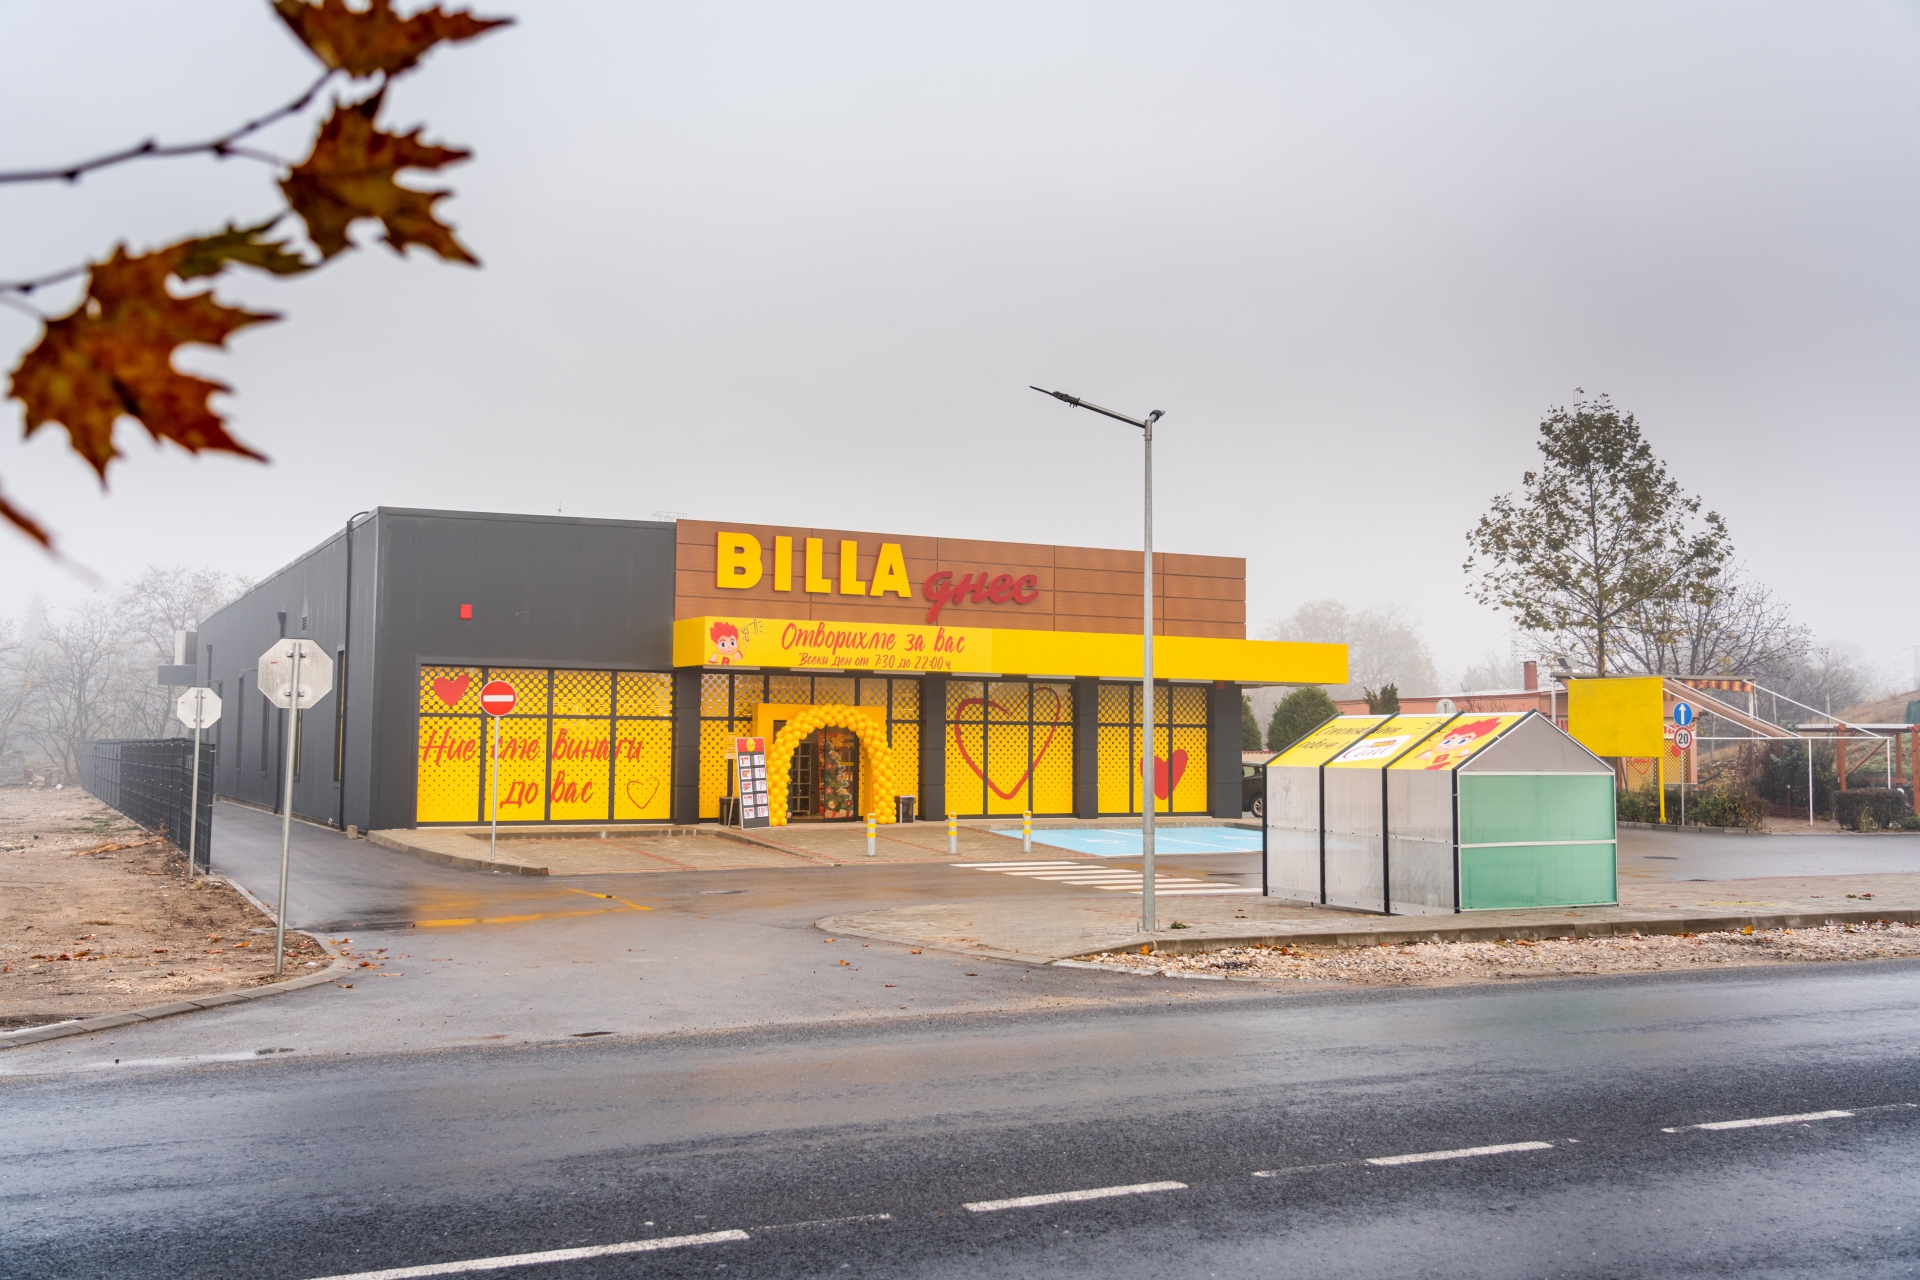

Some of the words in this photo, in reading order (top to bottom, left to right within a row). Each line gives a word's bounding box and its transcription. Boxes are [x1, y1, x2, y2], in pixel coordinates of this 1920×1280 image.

[716, 531, 912, 598] BILLA
[781, 621, 897, 656] Отворихме
[904, 633, 926, 652] за
[798, 652, 829, 666] Всеки
[831, 656, 852, 667] ден
[854, 656, 869, 667] от
[875, 654, 895, 669] 7:30
[897, 658, 911, 669] до
[913, 656, 944, 670] 22:00
[419, 726, 478, 767] Ние
[1678, 733, 1689, 744] 20
[499, 781, 539, 809] до
